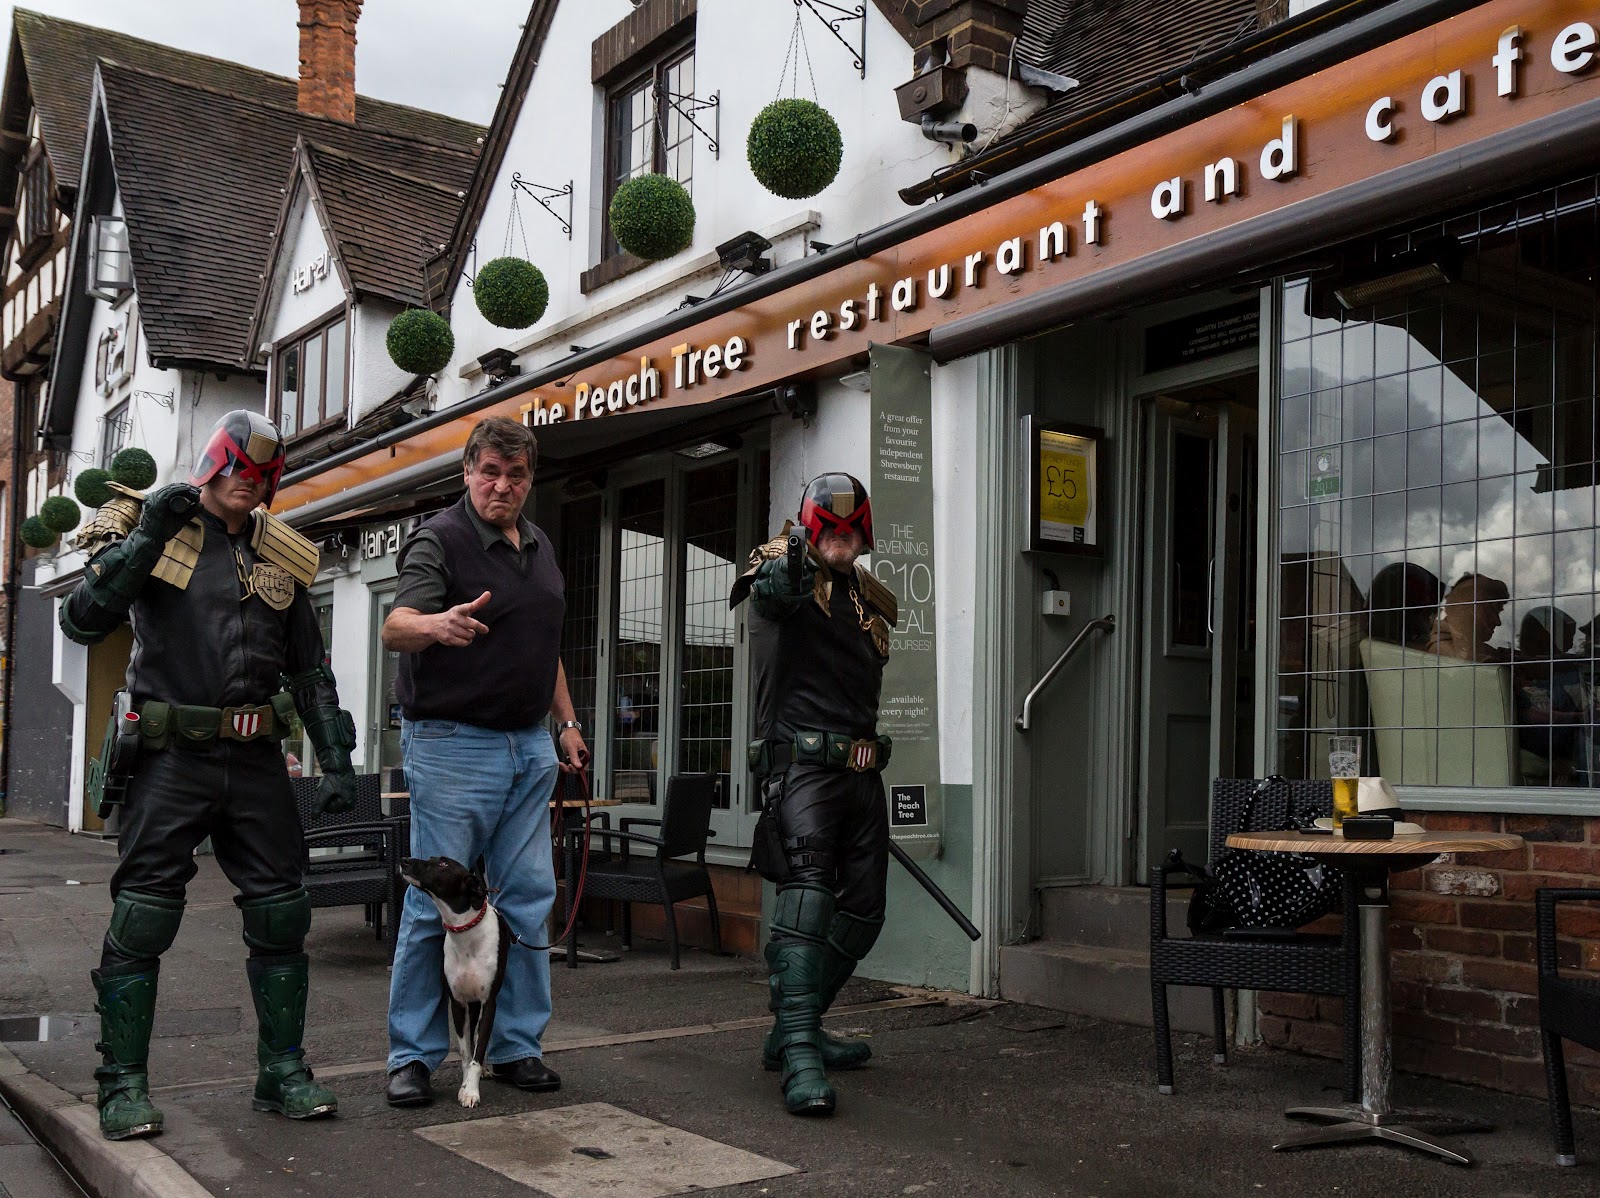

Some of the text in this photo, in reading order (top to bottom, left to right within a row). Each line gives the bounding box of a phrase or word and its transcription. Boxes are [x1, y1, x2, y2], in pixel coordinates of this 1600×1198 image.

[520, 21, 1600, 427] The Peach Tree restaurant and cafe
[880, 411, 923, 425] A great offer
[883, 424, 919, 436] from your
[885, 436, 917, 447] favourite
[880, 447, 923, 460] independent
[880, 459, 922, 473] Shrewsbury
[884, 472, 920, 483] restaurant
[1046, 465, 1077, 500] £5
[890, 523, 914, 539] THE
[877, 539, 929, 557] EVENING
[888, 609, 934, 635] EAL
[881, 708, 903, 719] every
[897, 793, 911, 801] The
[898, 801, 920, 810] Peach
[898, 810, 915, 819] Tree
